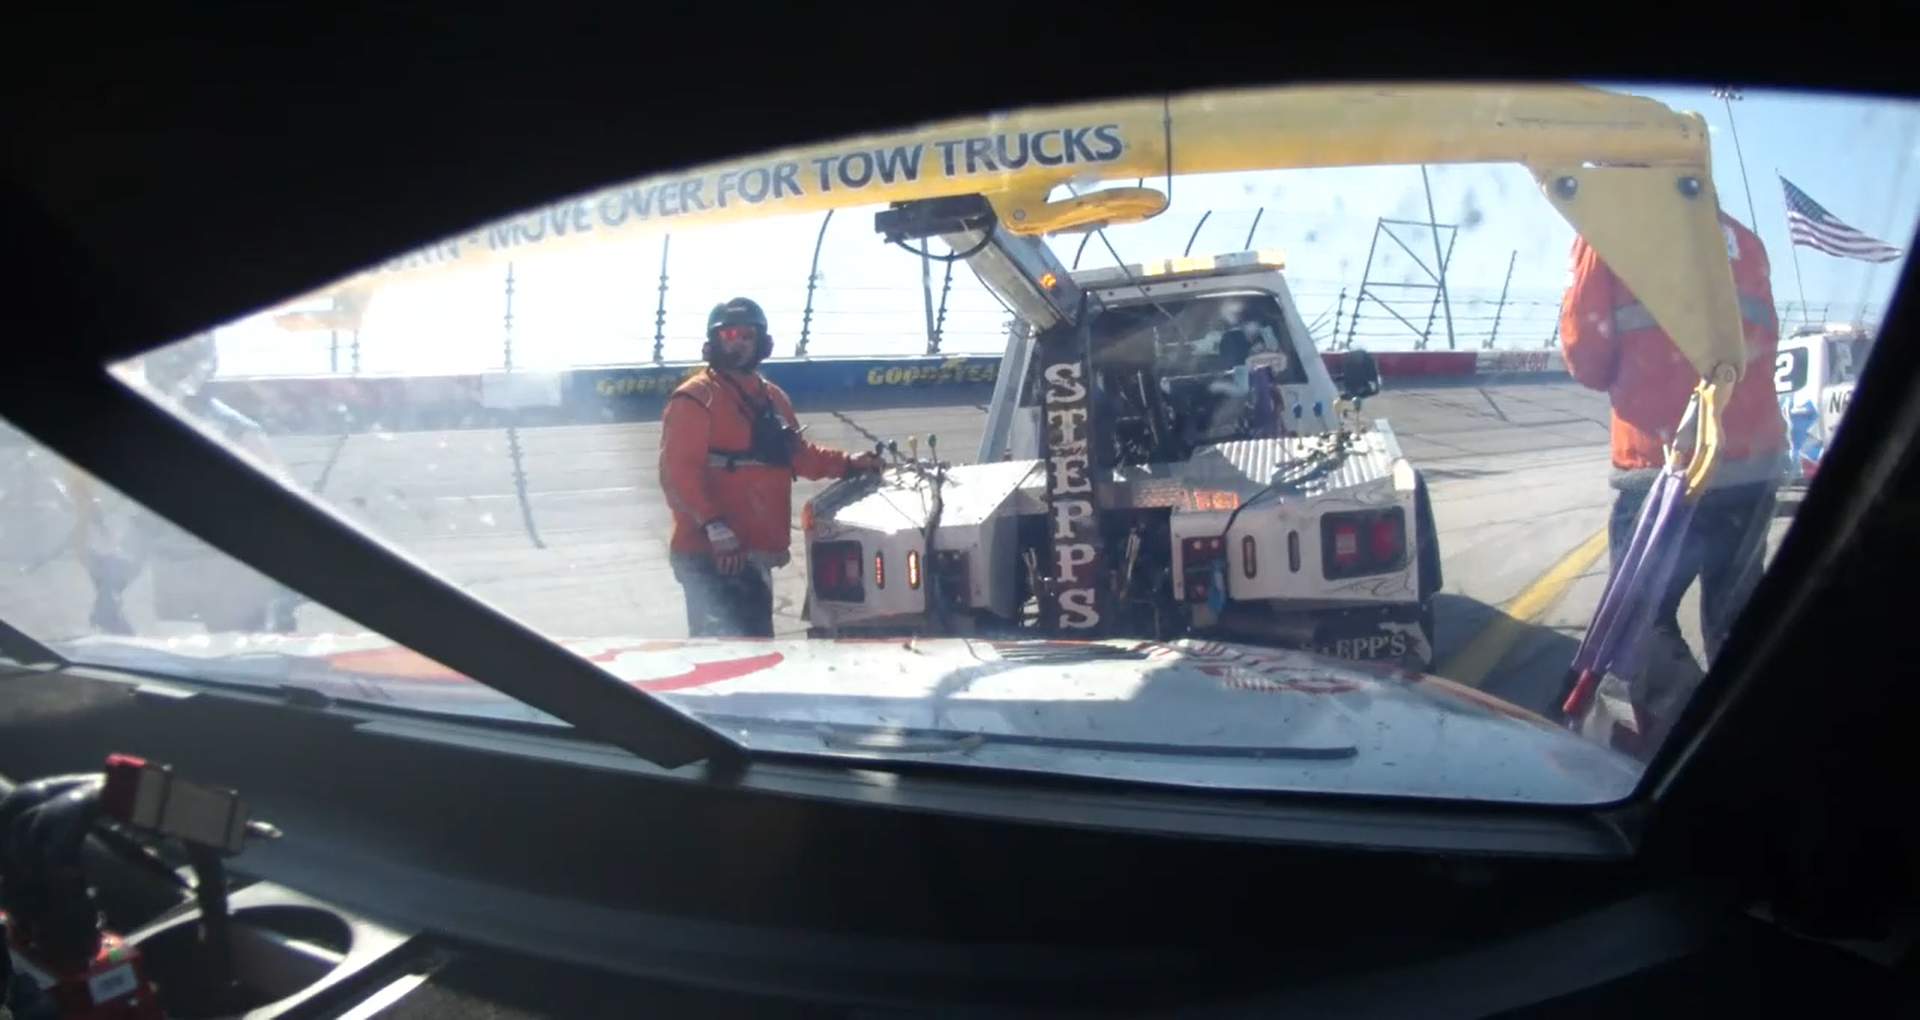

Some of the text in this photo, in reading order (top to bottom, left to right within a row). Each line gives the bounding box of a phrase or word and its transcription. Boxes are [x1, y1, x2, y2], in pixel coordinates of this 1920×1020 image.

[488, 200, 593, 250] MOVE
[598, 177, 708, 227] OVER
[716, 162, 804, 209] FOR
[811, 144, 923, 192] TOW
[934, 124, 1124, 177] TRUCKS
[1044, 360, 1100, 630] STEPPS
